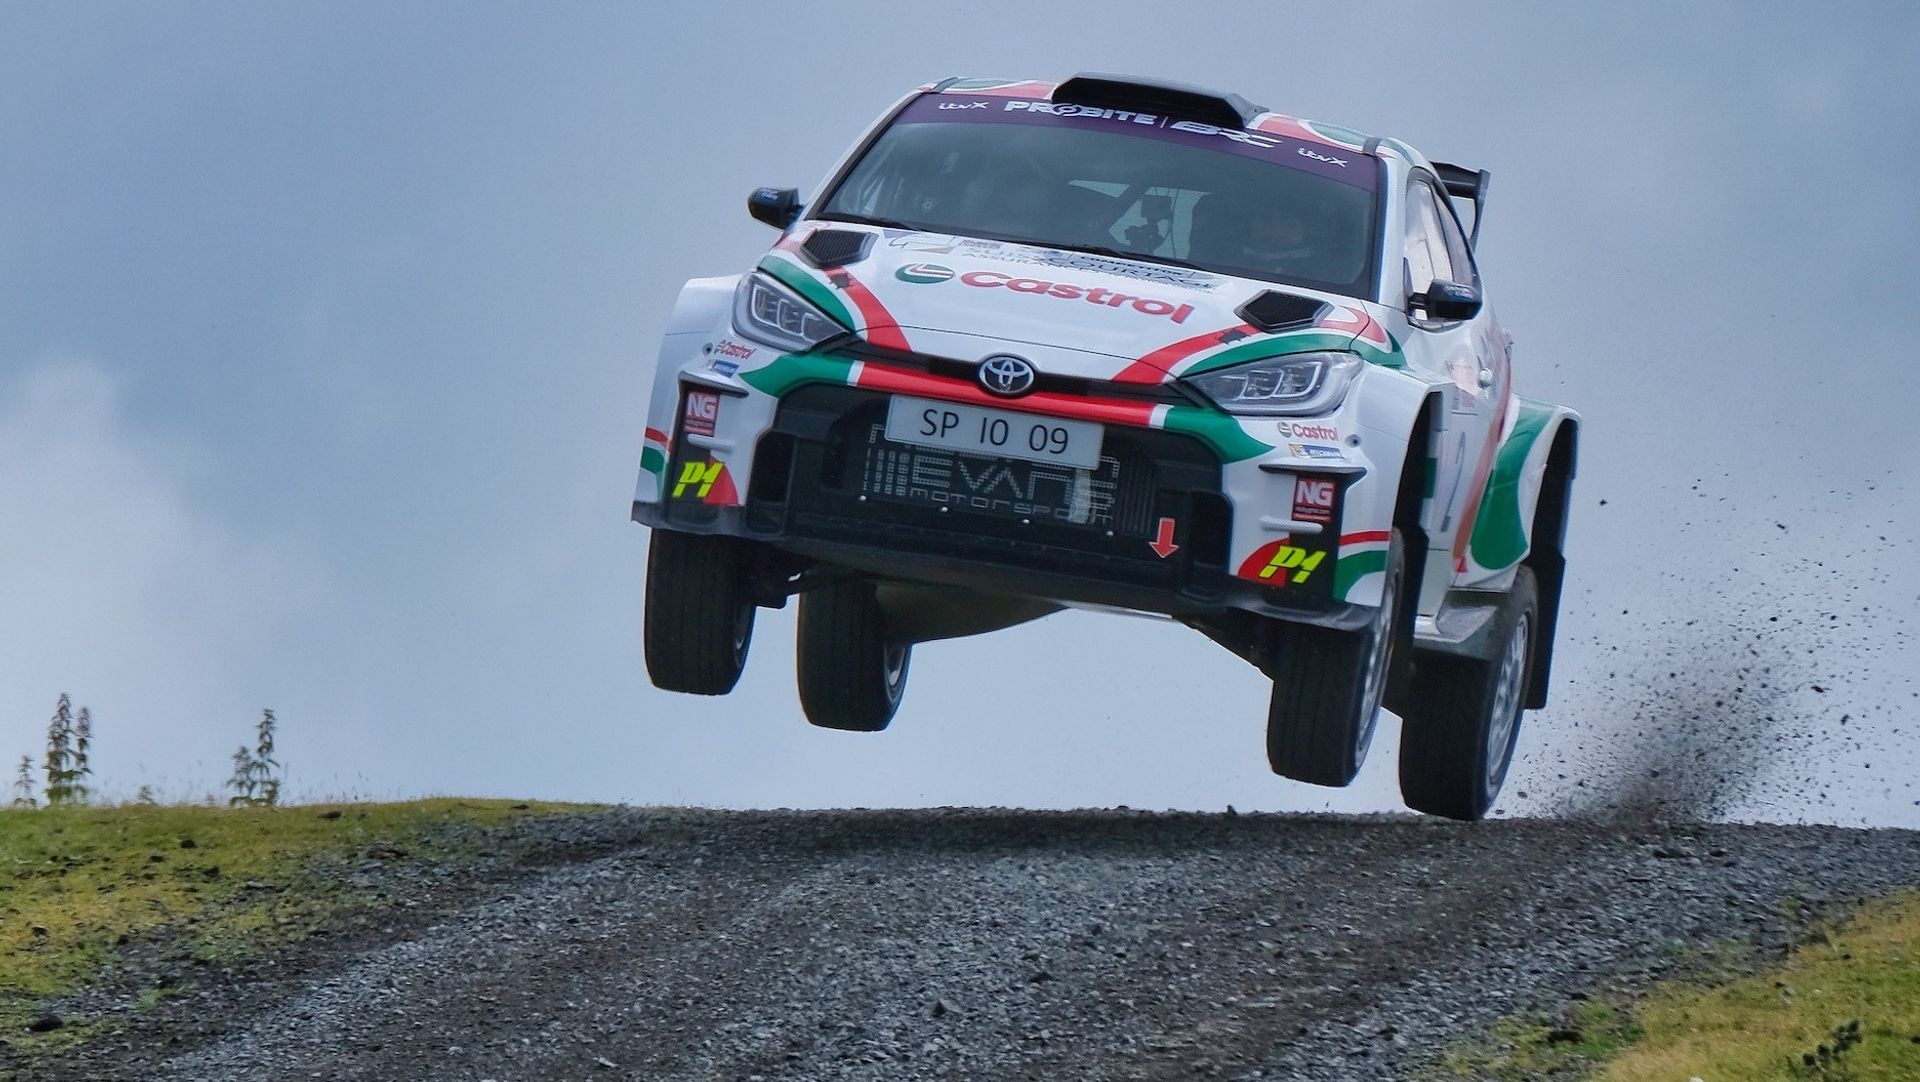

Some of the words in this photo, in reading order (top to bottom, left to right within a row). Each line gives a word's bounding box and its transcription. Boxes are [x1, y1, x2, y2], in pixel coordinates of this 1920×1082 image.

[1004, 100, 1158, 126] PROBITE
[960, 271, 1195, 325] Castrol
[687, 393, 718, 419] NG
[920, 408, 960, 439] SP
[1028, 424, 1070, 455] 09
[1291, 422, 1339, 442] Castrol
[1296, 480, 1335, 507] NG
